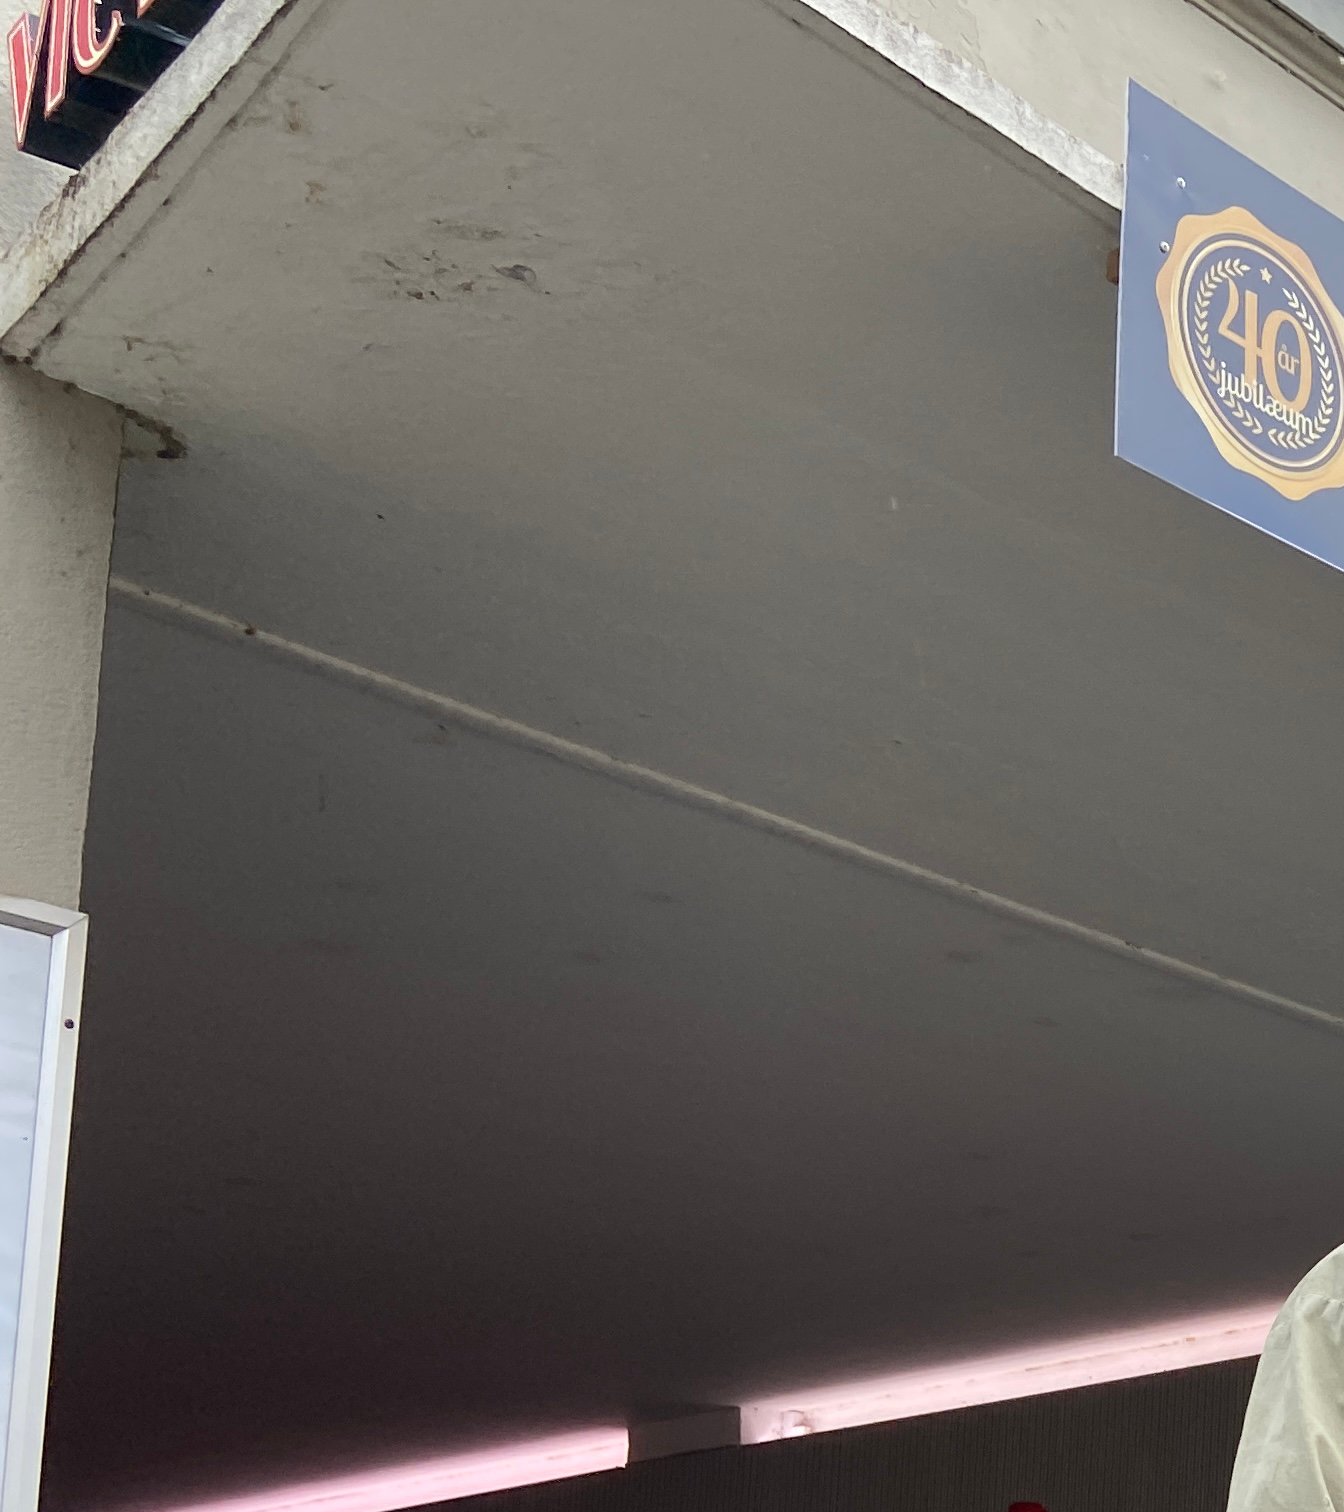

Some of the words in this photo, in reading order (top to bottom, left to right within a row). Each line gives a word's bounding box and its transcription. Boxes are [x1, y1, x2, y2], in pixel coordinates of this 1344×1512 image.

[1217, 276, 1313, 412] 40
[1277, 344, 1300, 375] år
[1216, 361, 1314, 438] jubilæum
